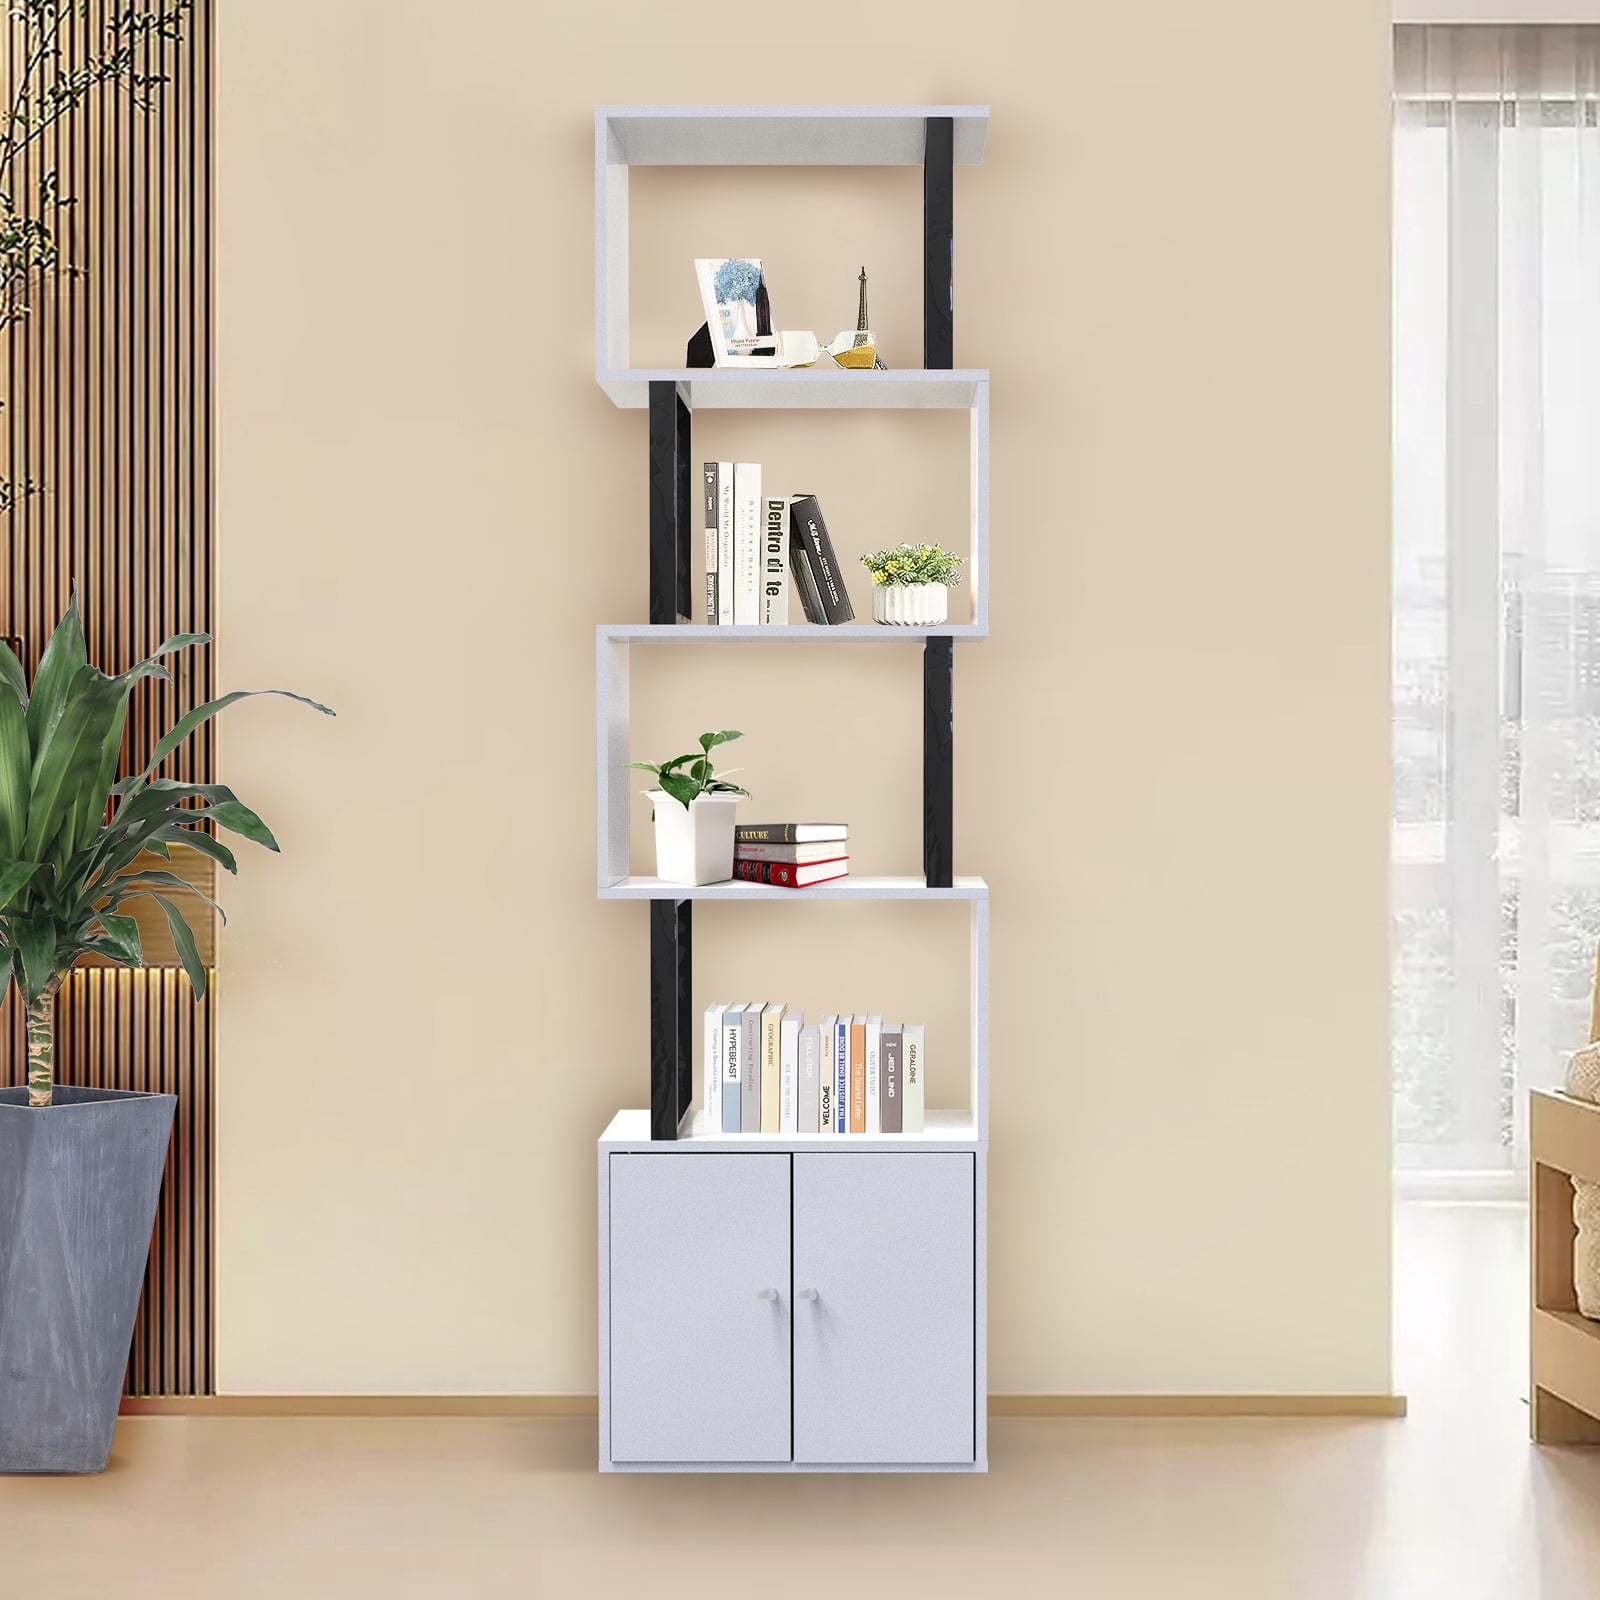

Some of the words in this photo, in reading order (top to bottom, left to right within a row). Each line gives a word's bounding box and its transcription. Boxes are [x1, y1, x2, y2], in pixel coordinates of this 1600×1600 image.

[724, 486, 730, 496] My
[723, 520, 730, 530] My
[768, 500, 784, 552] Dentro
[767, 558, 783, 572] di
[766, 581, 781, 596] te
[736, 831, 769, 839] CULTURE
